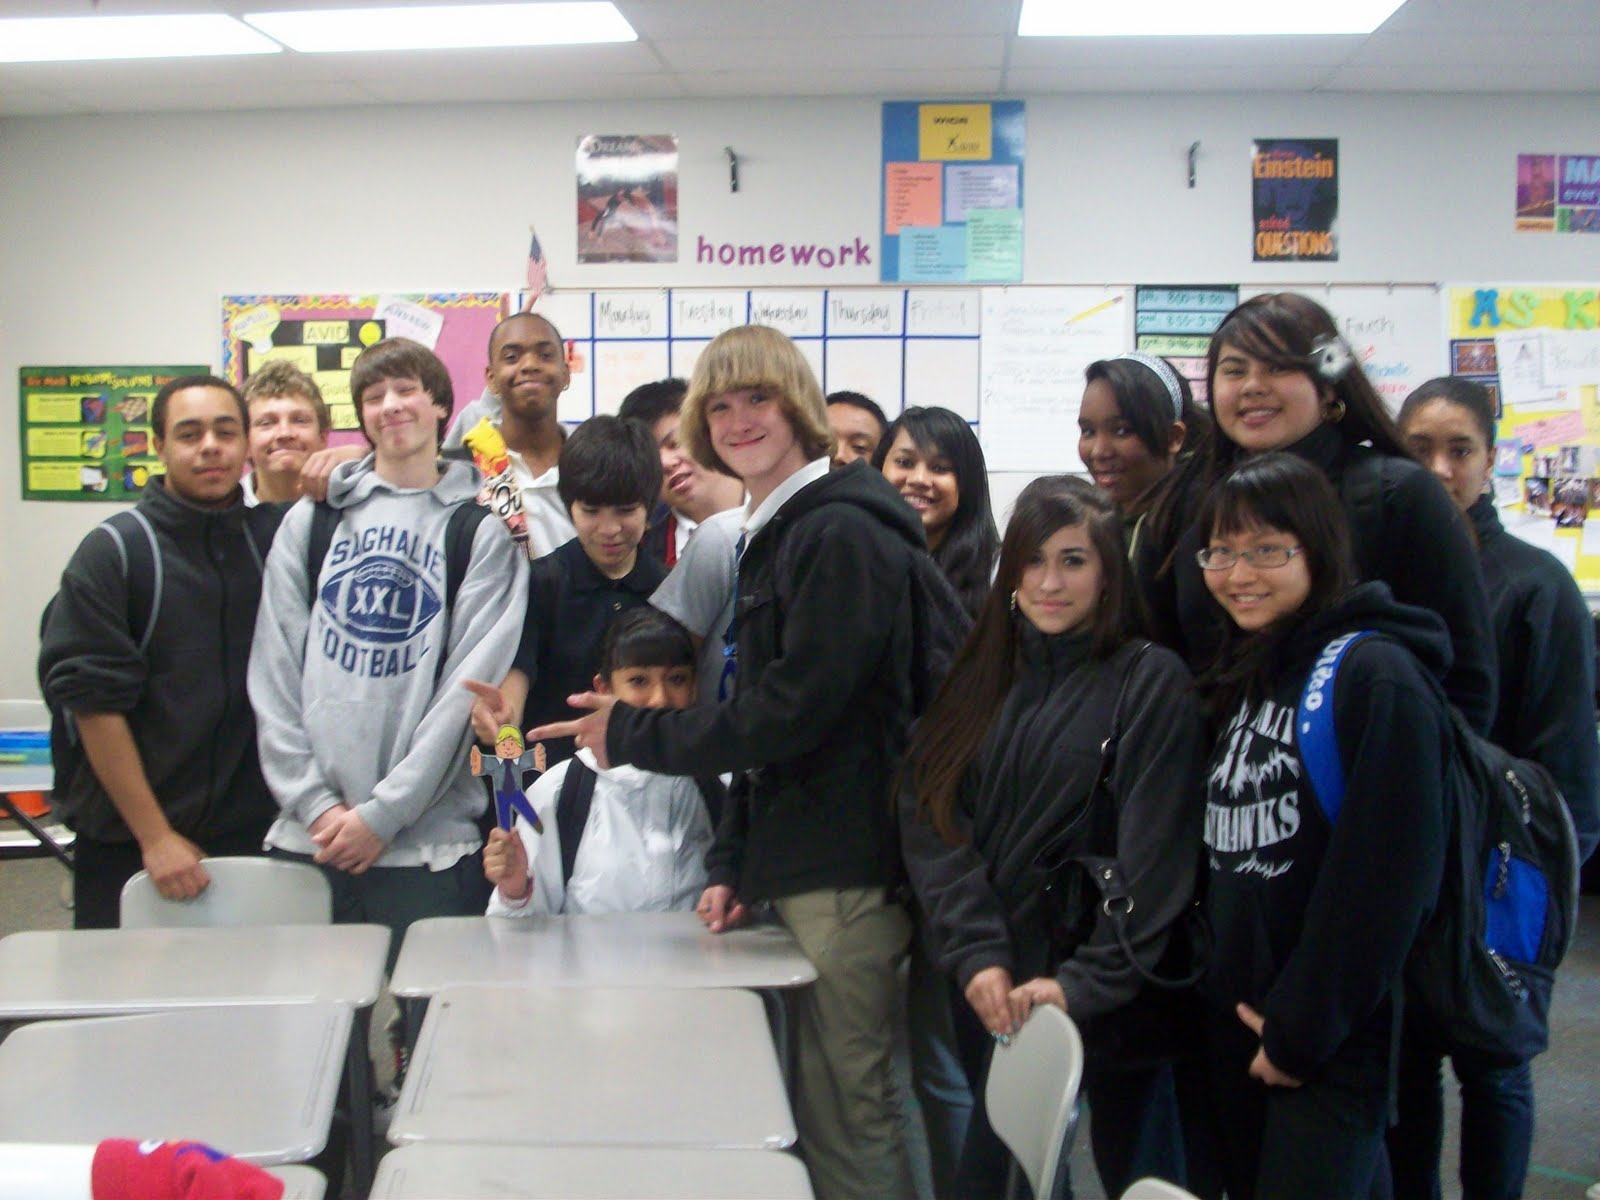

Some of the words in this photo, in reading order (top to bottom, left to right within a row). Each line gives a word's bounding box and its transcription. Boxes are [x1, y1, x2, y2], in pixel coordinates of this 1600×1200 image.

[1254, 152, 1334, 178] Einstein
[697, 236, 872, 268] homework
[1256, 231, 1334, 257] QUESTIONS
[599, 300, 652, 335] Monday
[677, 300, 734, 331] Tuesday
[831, 300, 891, 331] Thursday
[306, 325, 348, 341] AVID
[350, 585, 411, 620] XXL
